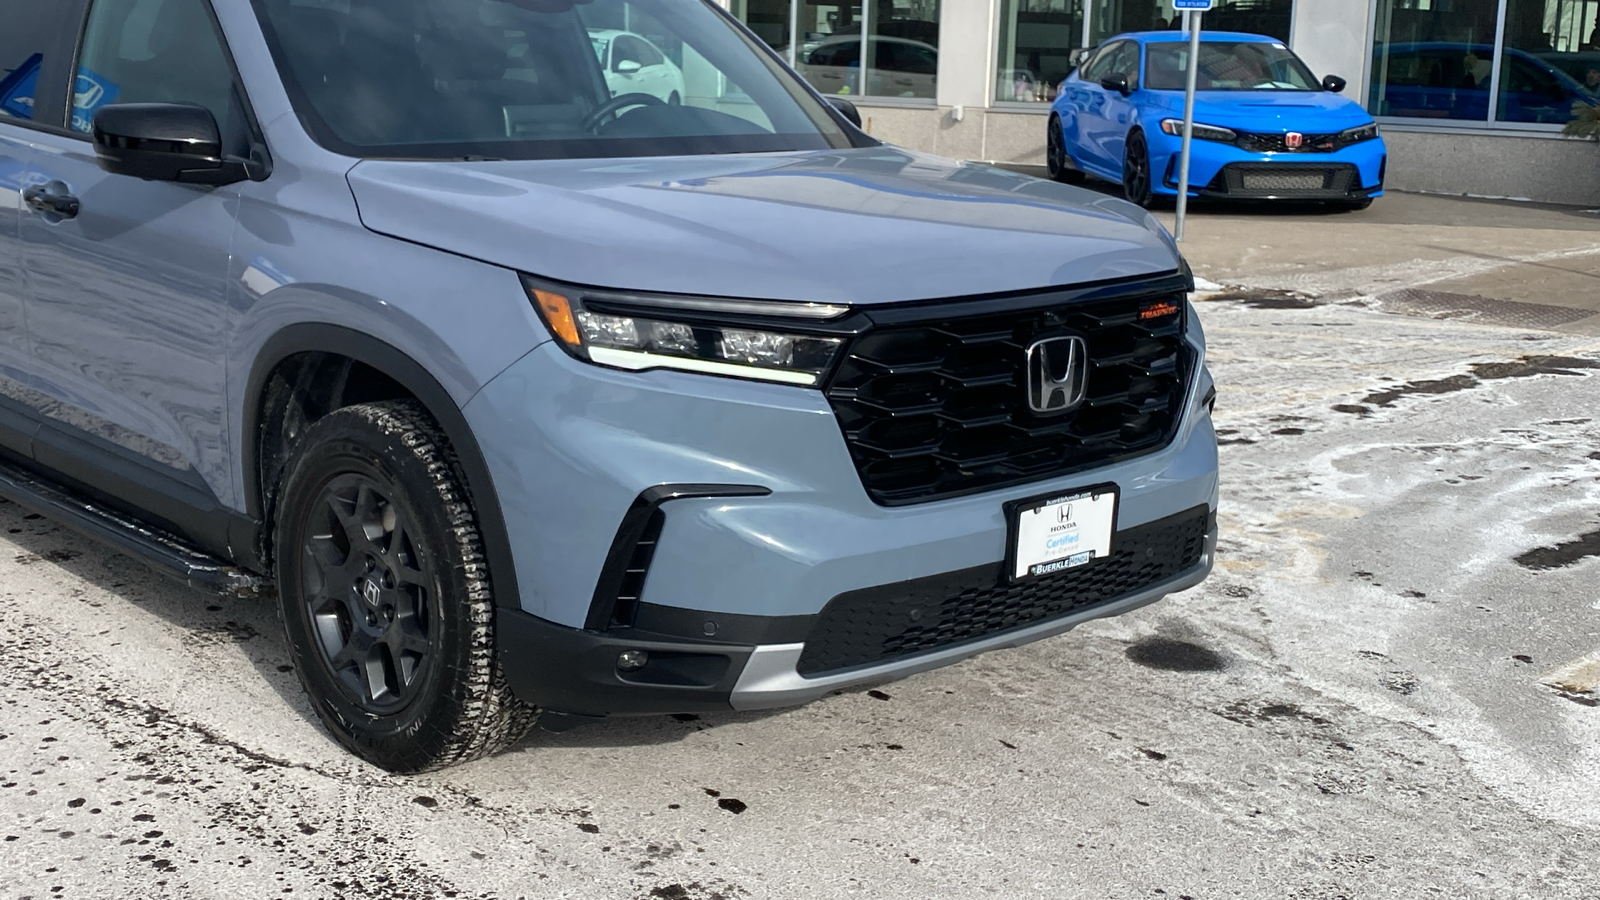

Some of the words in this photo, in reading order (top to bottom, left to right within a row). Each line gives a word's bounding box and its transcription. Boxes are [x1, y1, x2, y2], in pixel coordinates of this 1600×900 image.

[1050, 522, 1077, 532] HONDA
[1046, 533, 1080, 549] Certified
[1036, 560, 1069, 574] BUERKLE
